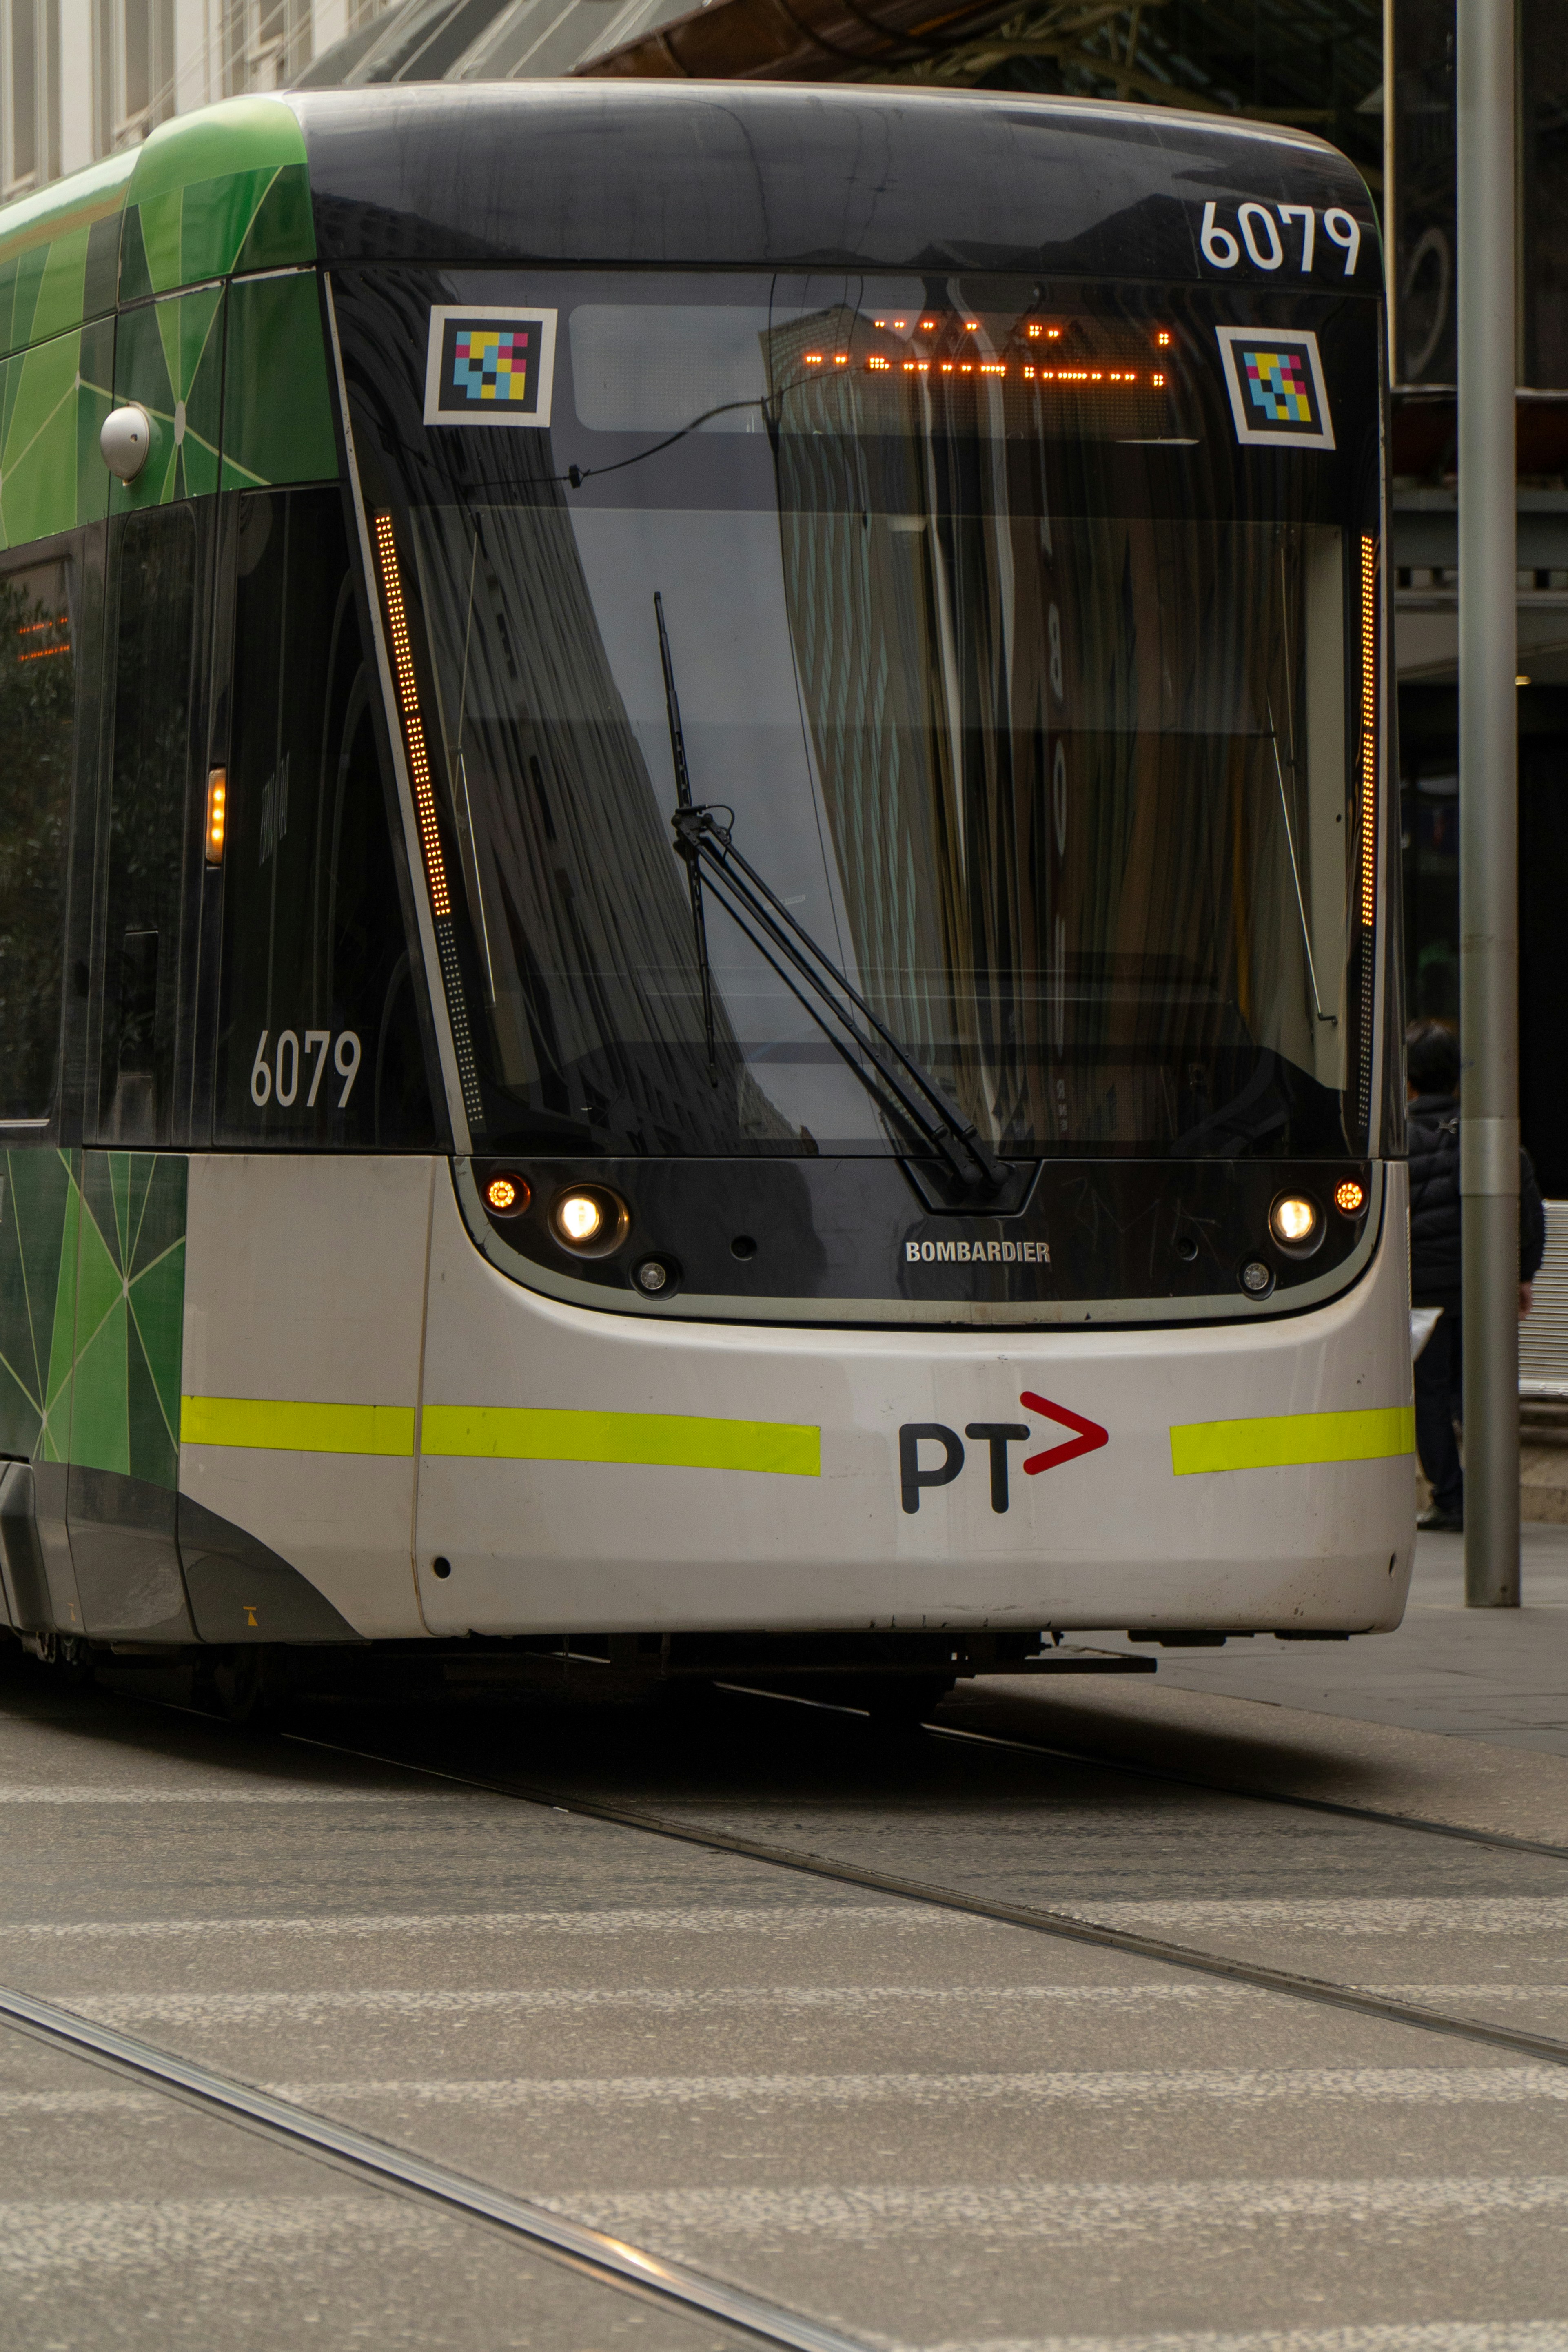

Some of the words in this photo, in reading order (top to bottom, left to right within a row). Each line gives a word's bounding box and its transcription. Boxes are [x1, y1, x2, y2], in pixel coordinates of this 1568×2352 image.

[1201, 202, 1360, 275] 6079
[251, 1030, 361, 1107] 6079
[905, 1241, 1050, 1262] BOMBARDIER
